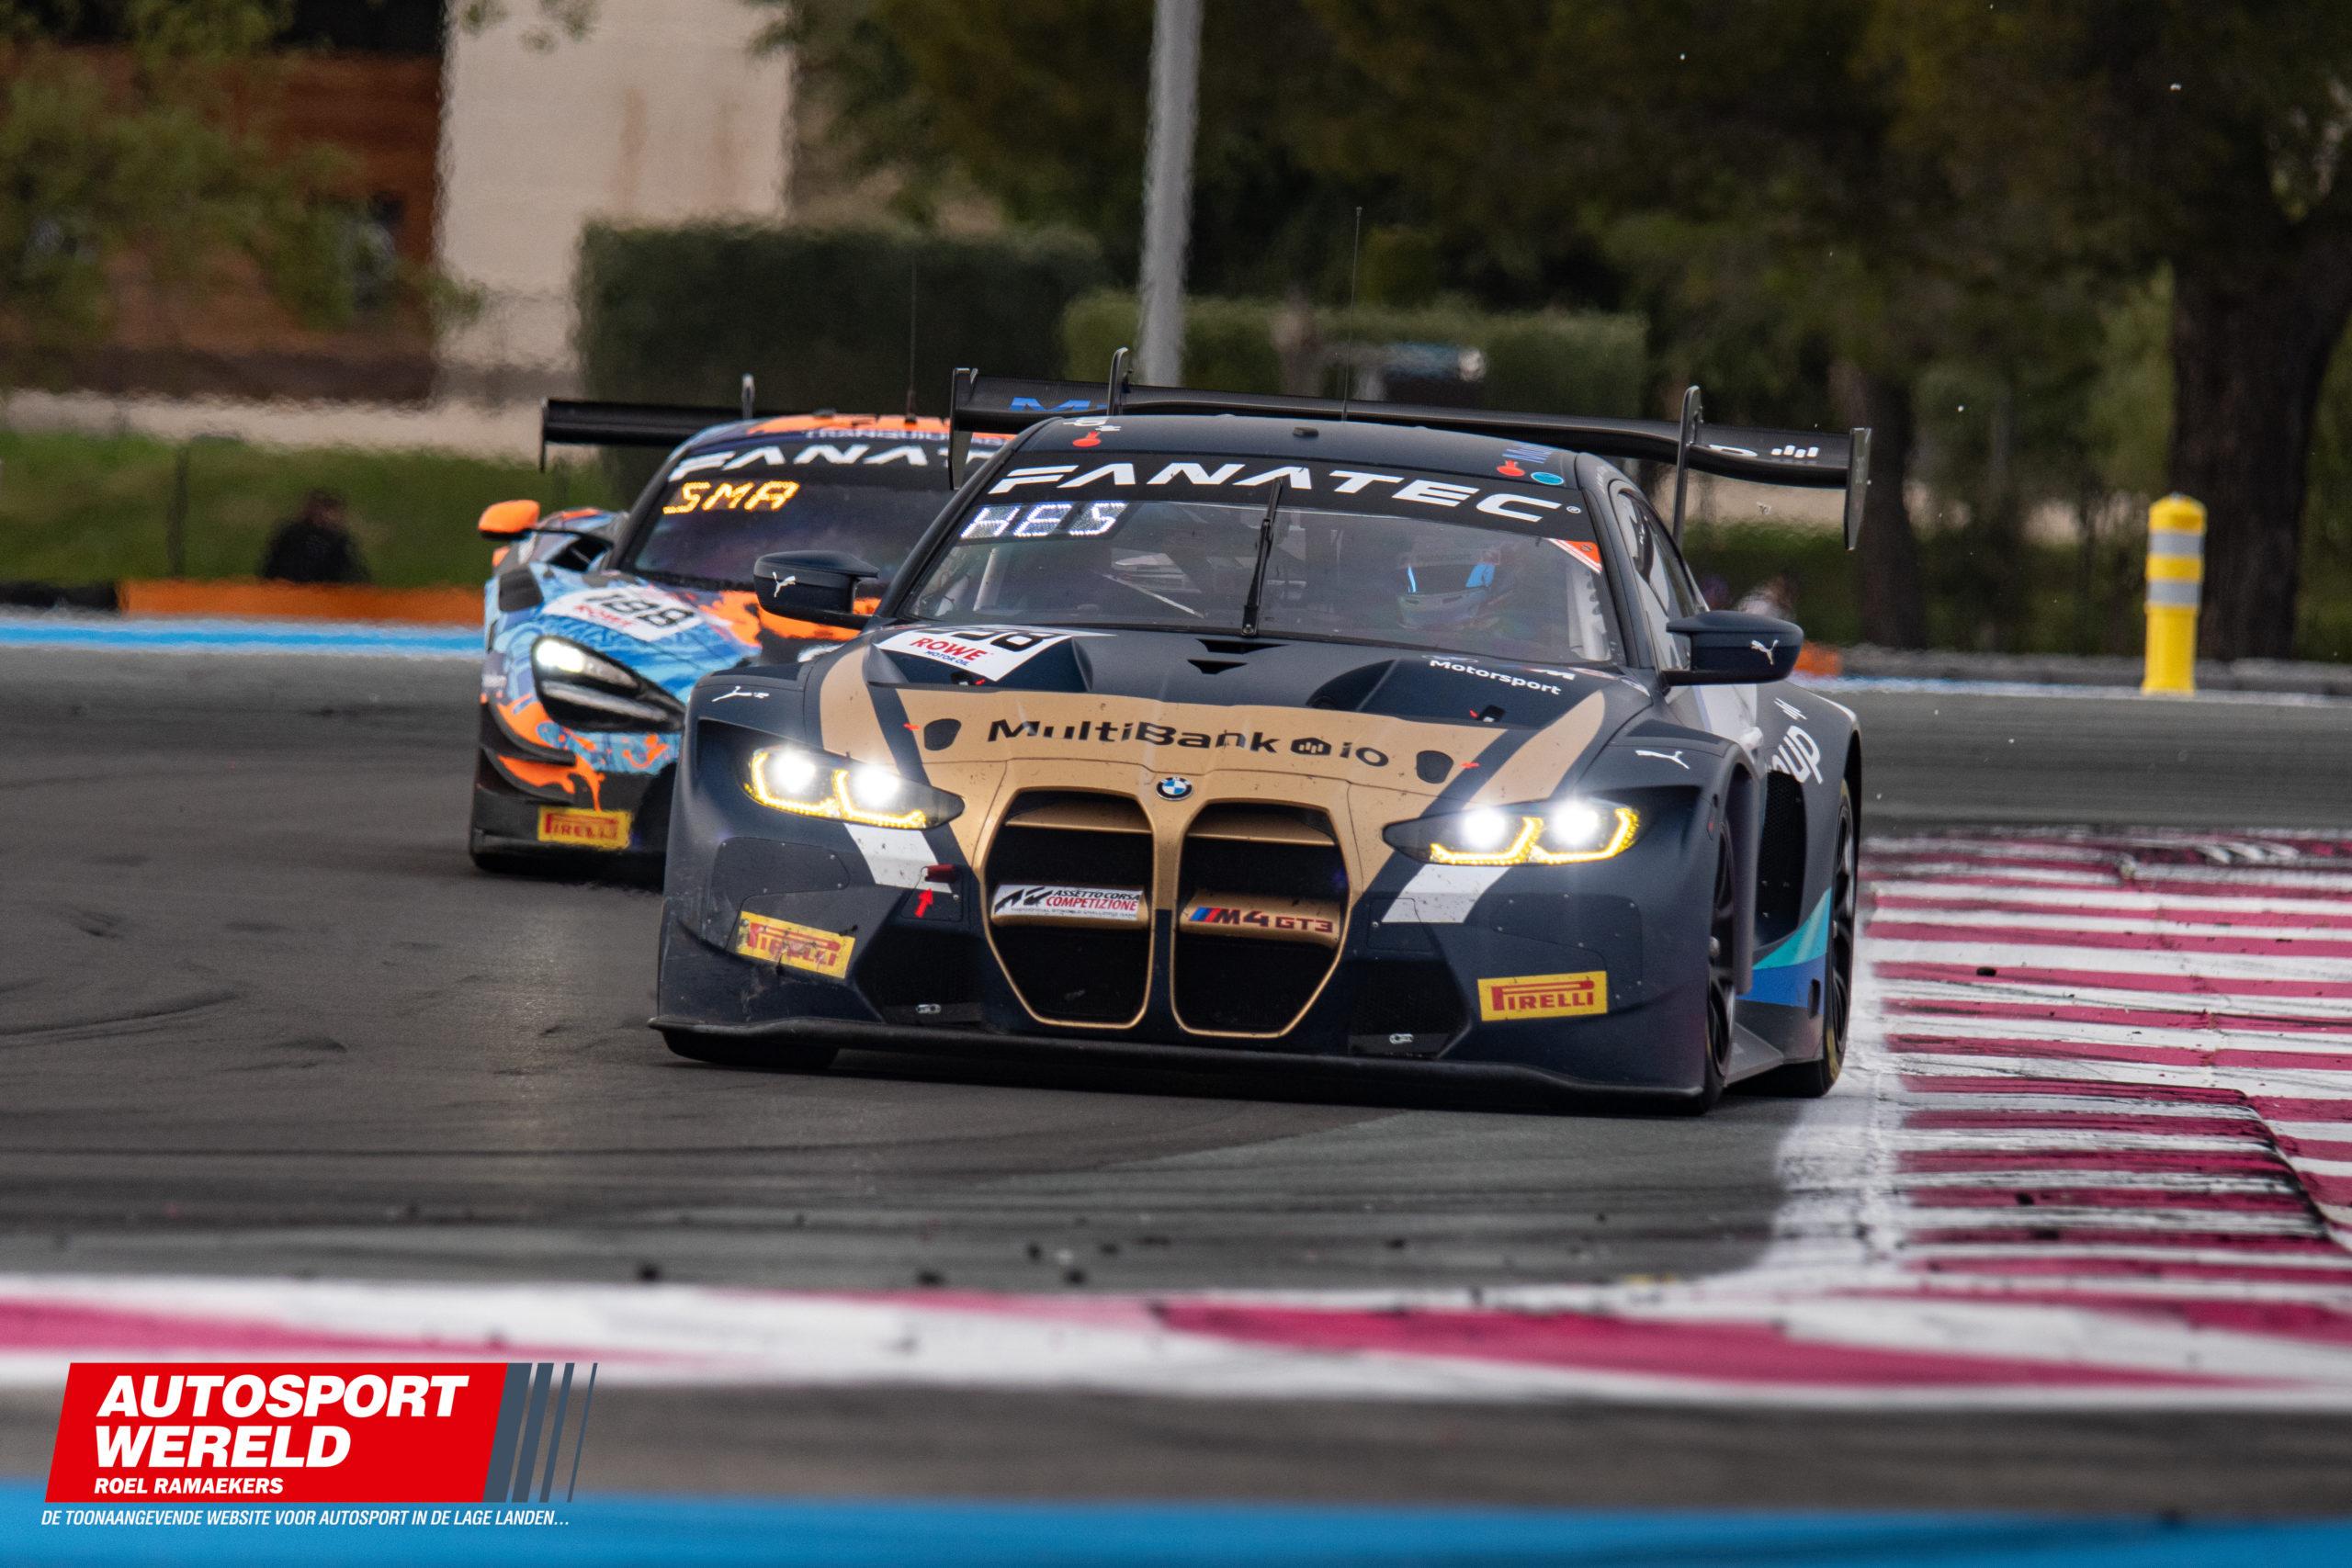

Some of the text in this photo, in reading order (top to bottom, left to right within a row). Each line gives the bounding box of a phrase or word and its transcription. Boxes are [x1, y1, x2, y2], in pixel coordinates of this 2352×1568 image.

[663, 481, 800, 514] SMA
[988, 462, 1562, 523] FANATEC
[960, 502, 1126, 538] HES
[910, 637, 987, 660] ROWE
[924, 650, 971, 666] MOTOR OIL
[1430, 660, 1562, 695] Motorsport
[988, 719, 1280, 753] MultiBank
[1046, 897, 1137, 911] COMPETIZIONE
[1053, 890, 1139, 900] ASSETTO CORSA
[1275, 916, 1333, 933] GT3
[1491, 980, 1595, 1011] PIRELLI
